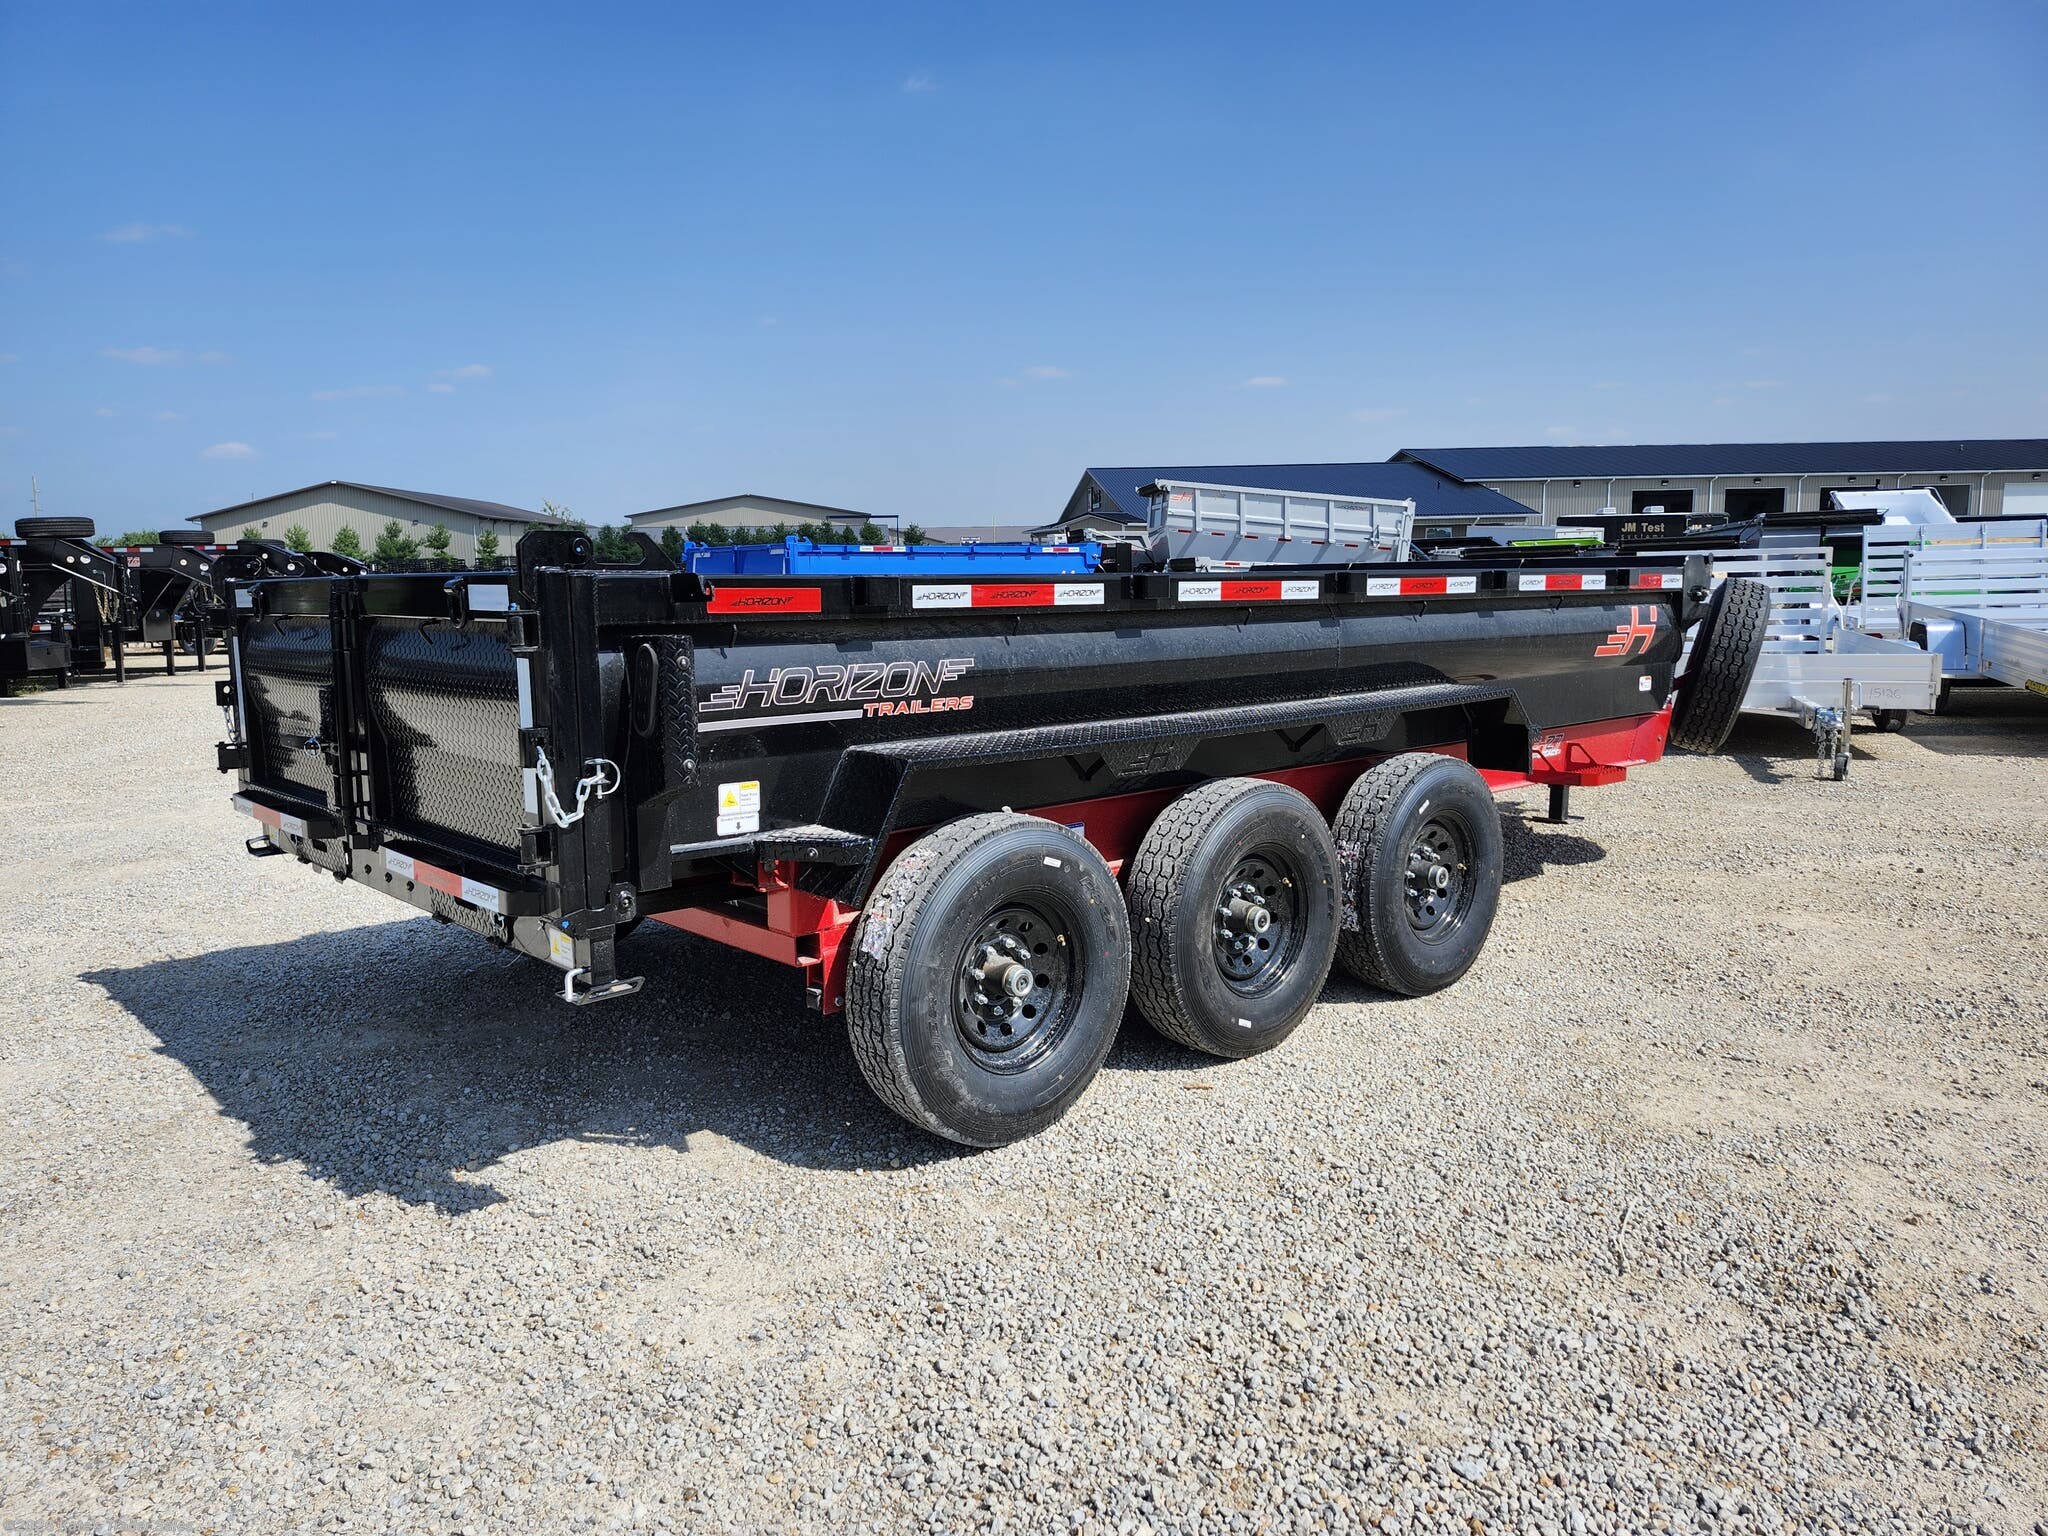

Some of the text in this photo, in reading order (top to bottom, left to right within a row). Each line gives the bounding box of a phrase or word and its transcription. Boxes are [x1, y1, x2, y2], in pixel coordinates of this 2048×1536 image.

[1621, 522, 1665, 533] JM Test
[921, 592, 962, 601] HORIZON
[995, 590, 1033, 599] HORIZON
[1062, 589, 1097, 597] HORIZON
[736, 596, 789, 607] HORIZON
[735, 660, 949, 709] HORIZON
[863, 696, 974, 718] TRAILERS
